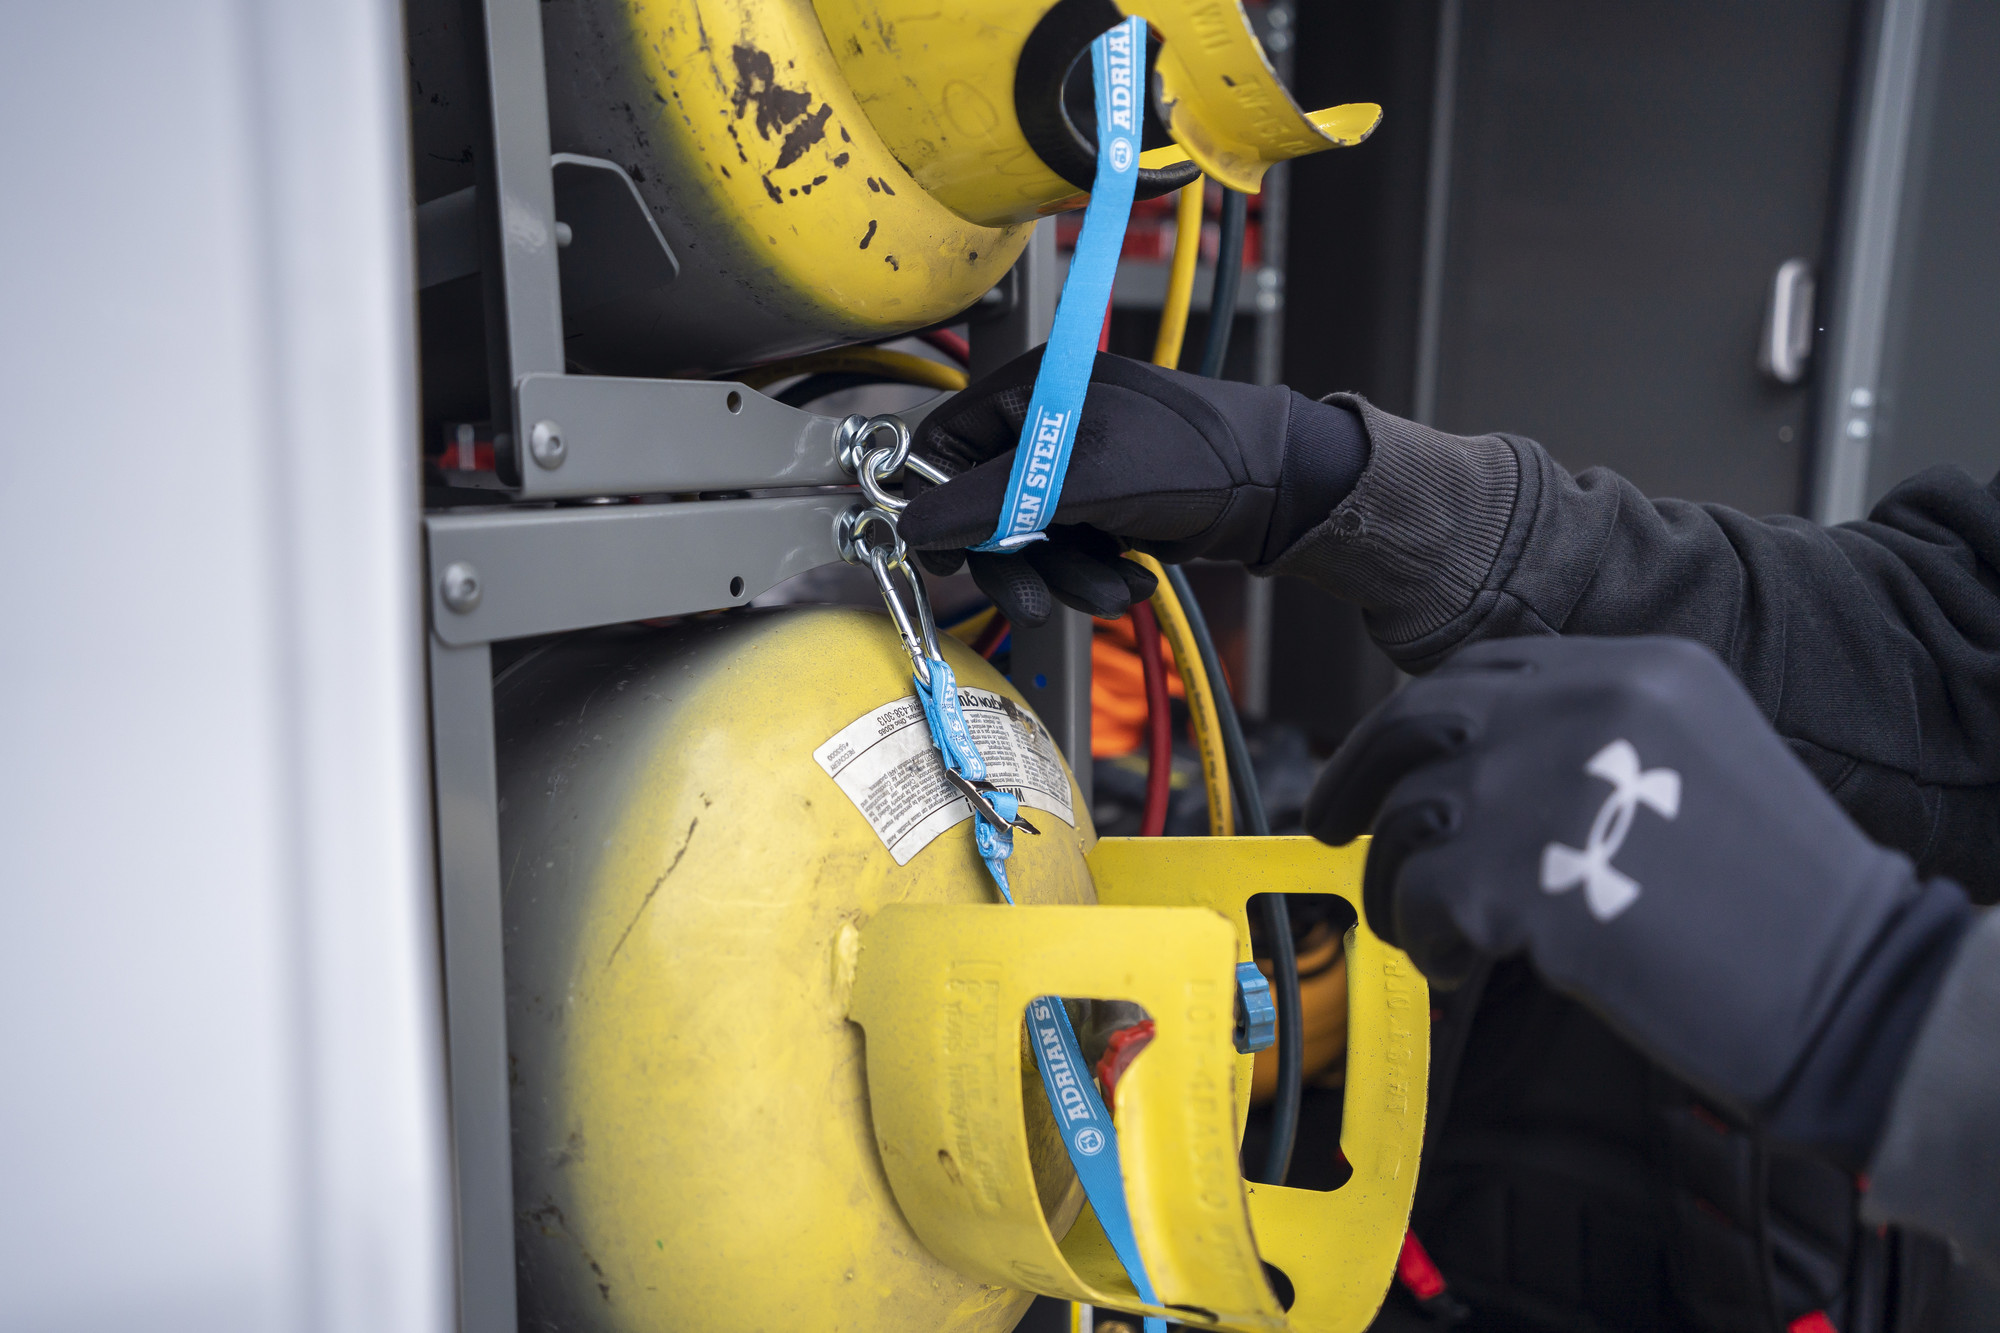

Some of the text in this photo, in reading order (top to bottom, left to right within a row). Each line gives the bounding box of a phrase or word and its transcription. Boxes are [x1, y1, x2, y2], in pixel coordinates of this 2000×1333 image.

[1013, 493, 1042, 536] IAN
[877, 723, 895, 736] 43085
[893, 717, 907, 727] Ohio
[829, 747, 856, 771] RECOVERY
[1040, 1028, 1091, 1122] ADRIAN
